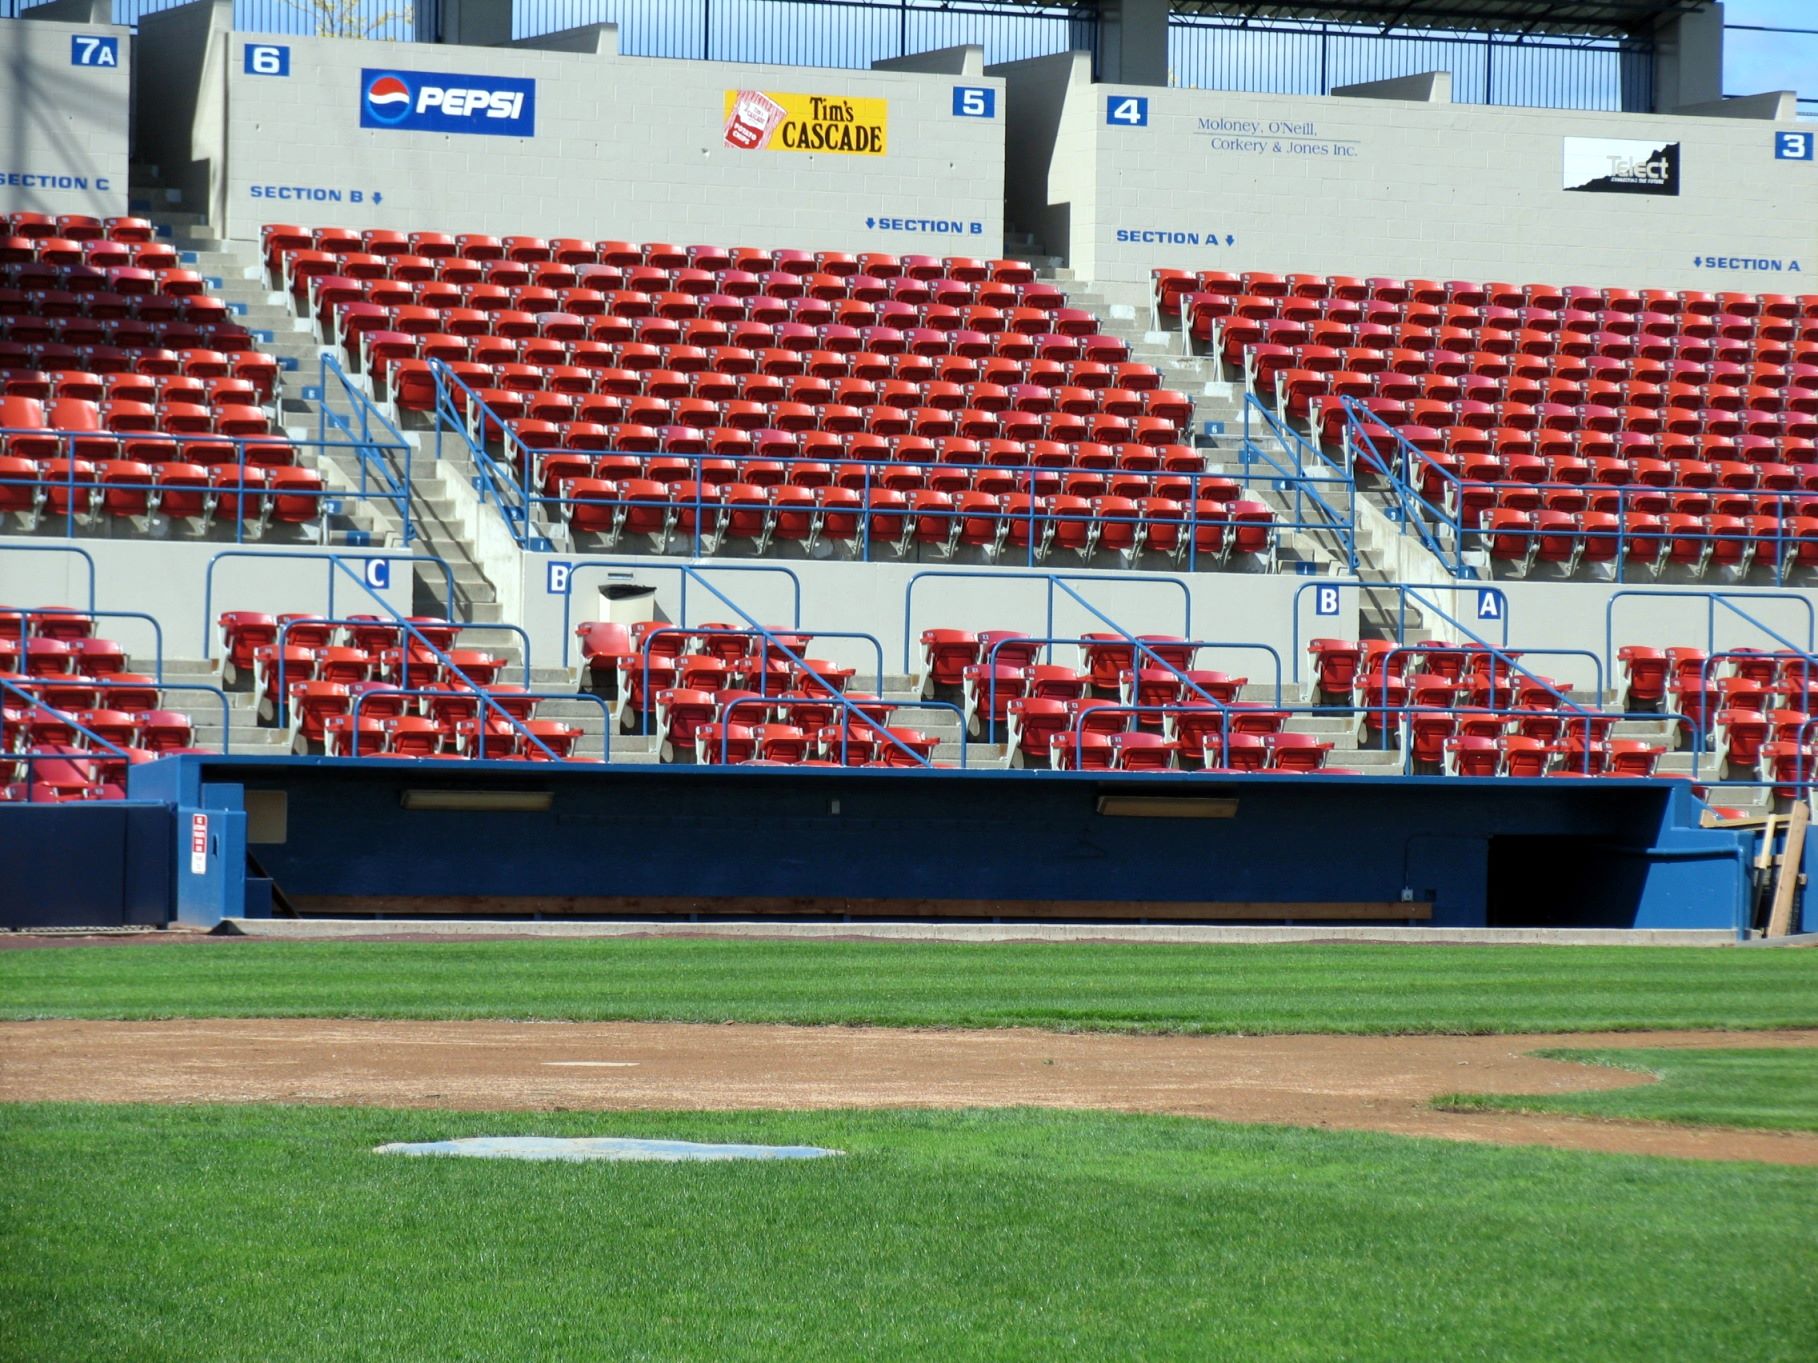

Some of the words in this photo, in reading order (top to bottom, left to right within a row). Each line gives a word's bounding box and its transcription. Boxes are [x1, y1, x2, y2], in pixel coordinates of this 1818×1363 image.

[76, 37, 115, 65] 7A
[253, 48, 280, 73] 6
[416, 87, 524, 119] PEPSI
[810, 97, 854, 122] Tim's
[963, 90, 985, 115] 5
[1114, 99, 1141, 124] 4
[782, 121, 882, 152] CASCADE
[1268, 121, 1318, 136] O'Neill,
[1211, 137, 1267, 154] Corkery
[1272, 144, 1282, 153] &
[1286, 142, 1328, 155] Jones
[1333, 143, 1358, 156] Inc.
[1782, 134, 1806, 158] 3
[1606, 155, 1669, 179] Telect
[95, 178, 110, 191] C
[250, 185, 342, 202] SECTION
[350, 189, 364, 203] B
[879, 217, 963, 234] SECTION
[969, 221, 983, 235] B
[1116, 229, 1199, 245] SECTION
[1205, 233, 1219, 246] A
[1705, 256, 1783, 272] SECTION
[1788, 260, 1801, 272] A
[368, 559, 386, 587] C
[550, 565, 569, 592] B
[1321, 588, 1337, 613] B
[1480, 592, 1498, 616] A
